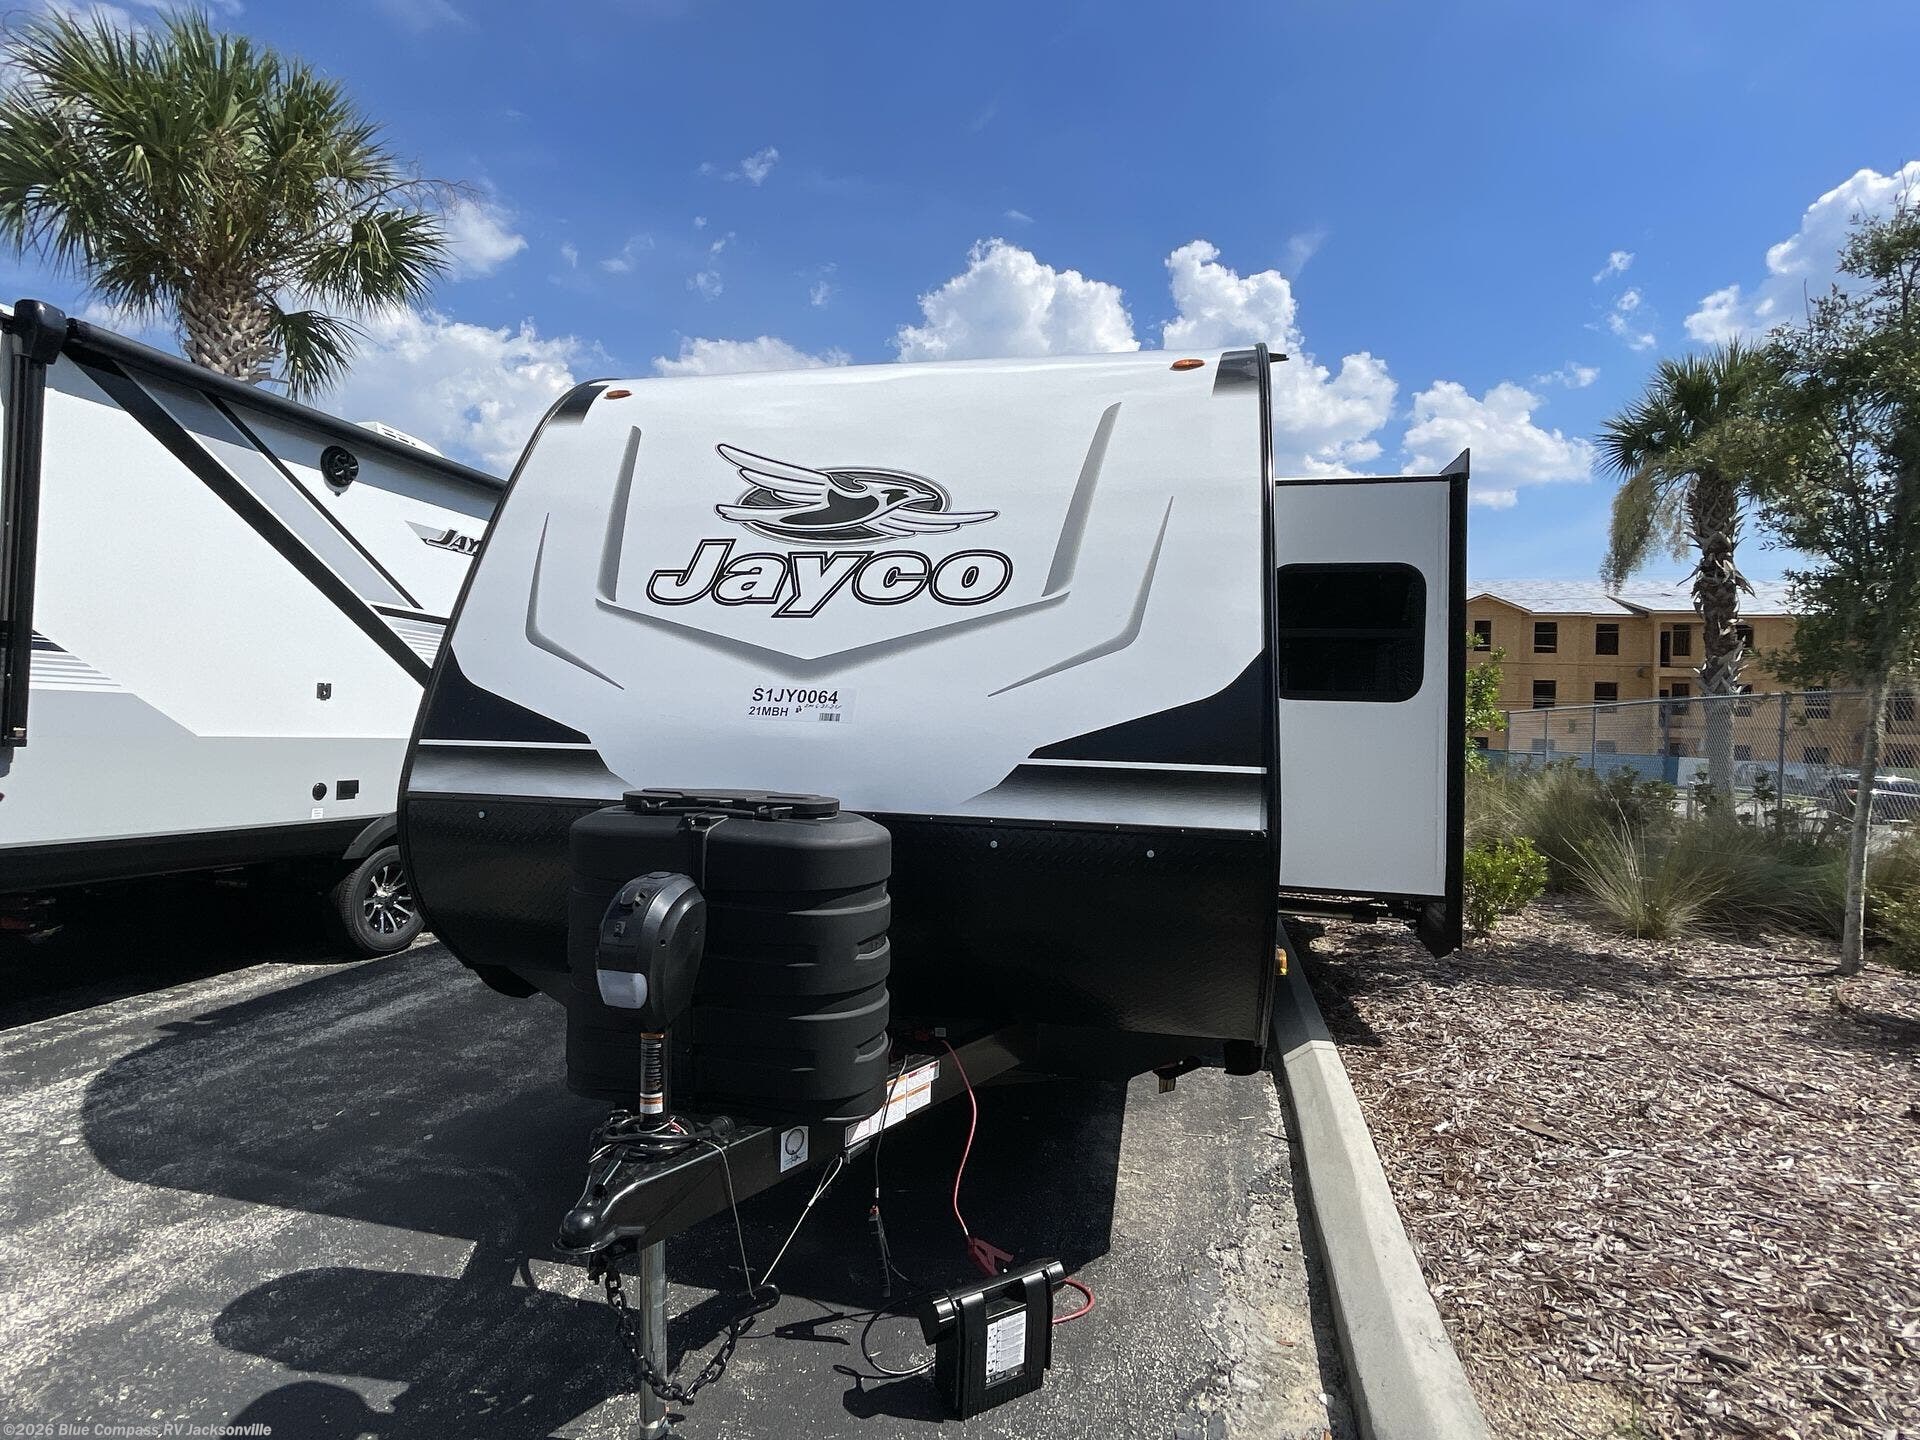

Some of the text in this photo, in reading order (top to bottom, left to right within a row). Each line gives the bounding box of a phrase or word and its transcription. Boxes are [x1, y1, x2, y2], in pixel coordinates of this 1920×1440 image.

[646, 538, 1013, 618] Jayco
[752, 687, 839, 704] S1JY0064
[748, 706, 789, 717] 21MBH
